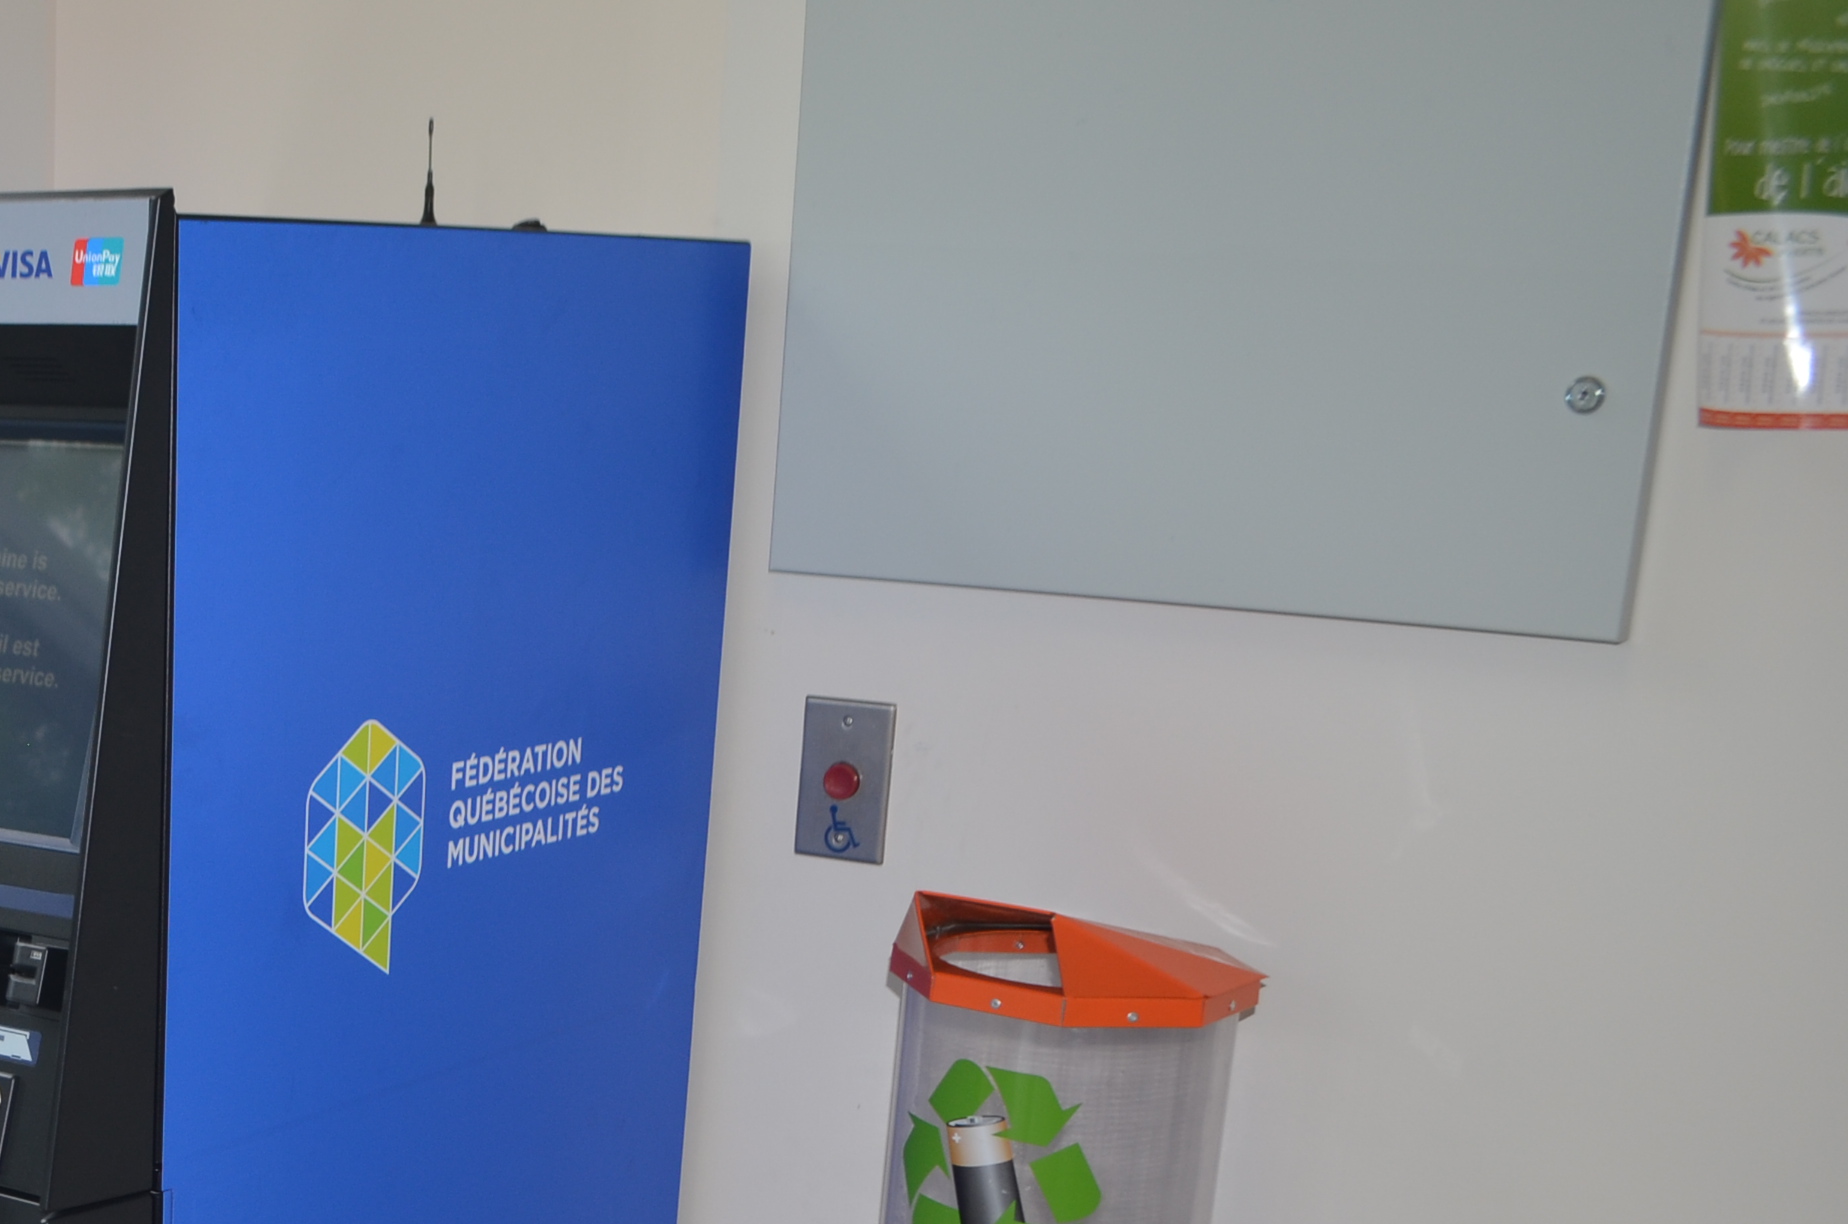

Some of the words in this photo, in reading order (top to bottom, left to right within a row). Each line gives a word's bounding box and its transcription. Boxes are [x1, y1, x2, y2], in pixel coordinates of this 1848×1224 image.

[74, 250, 120, 265] UnionPay
[32, 550, 48, 572] is
[12, 637, 41, 658] est
[451, 736, 583, 791] FÉDÉRATION
[448, 774, 581, 829] QUÉBÉCOISE
[586, 764, 624, 800] DES
[446, 804, 600, 869] MUNICIPALITÉS
